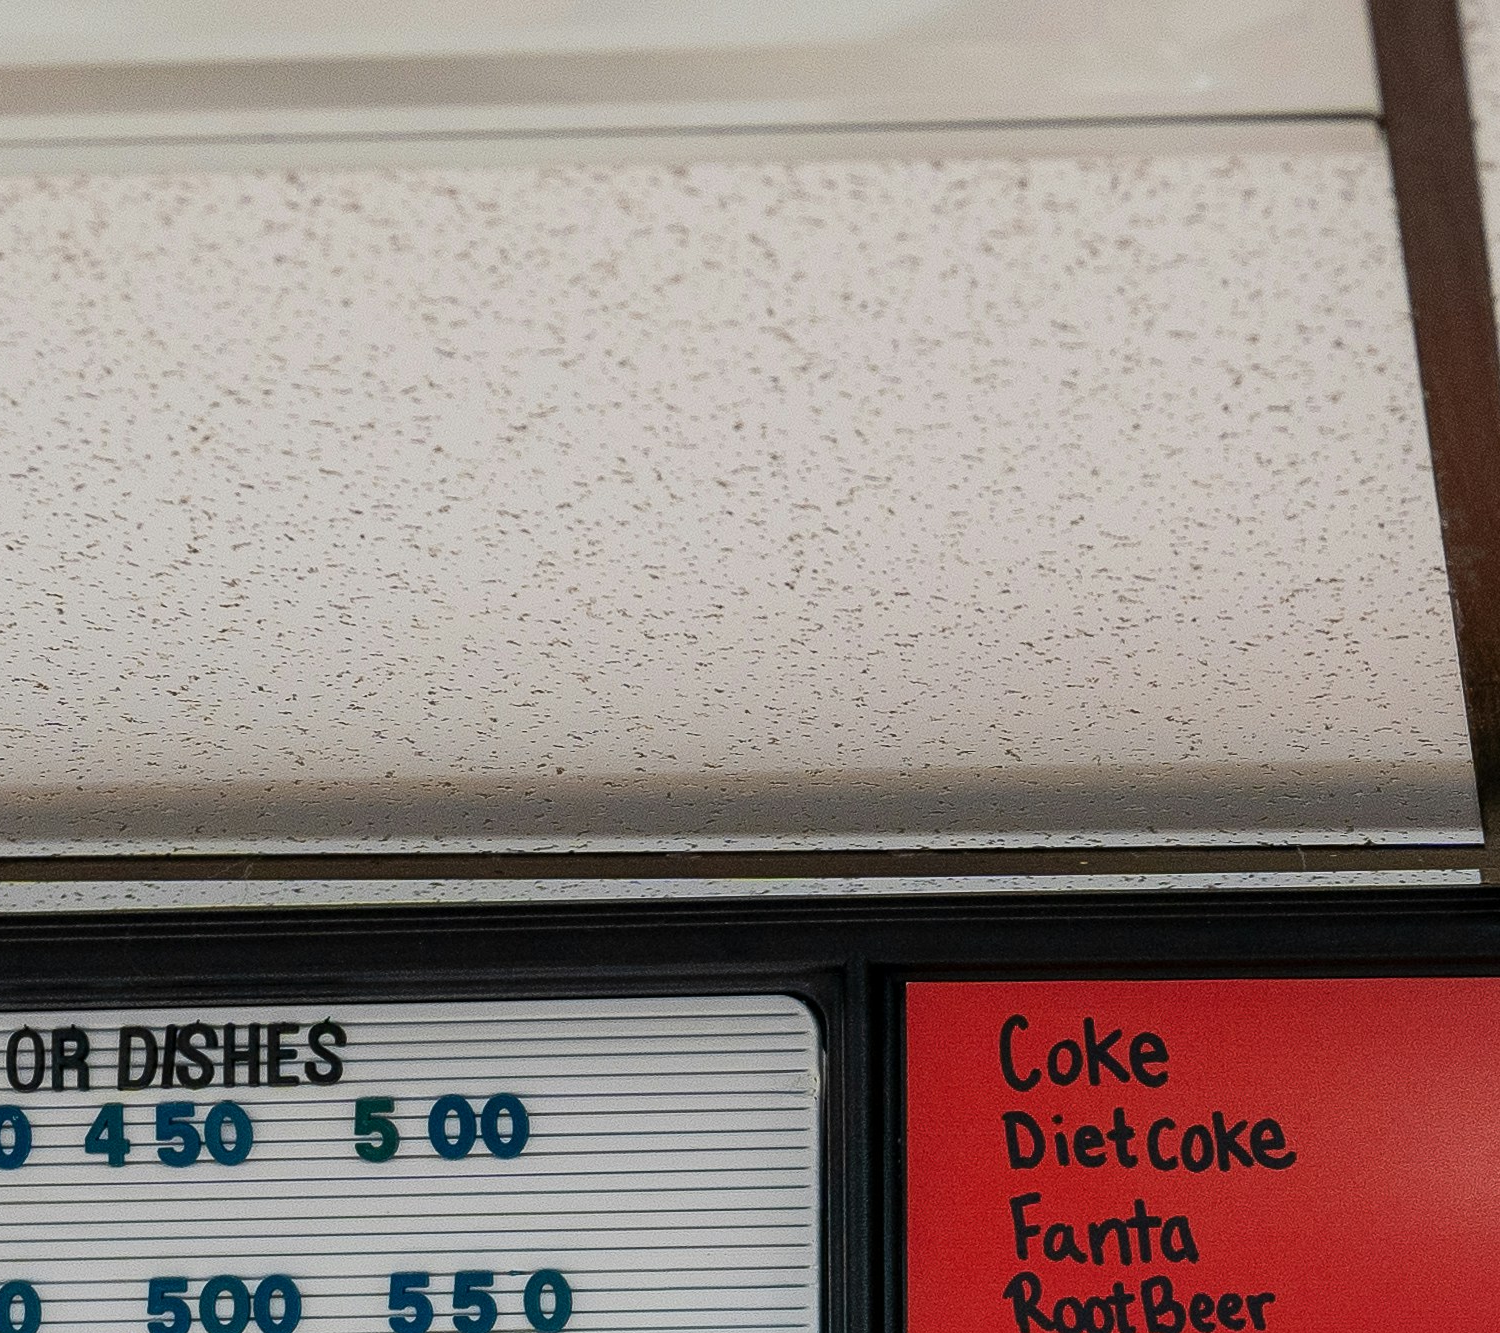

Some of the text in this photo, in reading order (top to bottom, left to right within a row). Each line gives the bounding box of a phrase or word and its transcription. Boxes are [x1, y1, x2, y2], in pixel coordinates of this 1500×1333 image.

[5, 1025, 92, 1093] OR
[117, 1018, 347, 1089] DISHES
[998, 1014, 1170, 1089] Coke
[1009, 1193, 1199, 1266] Fanta
